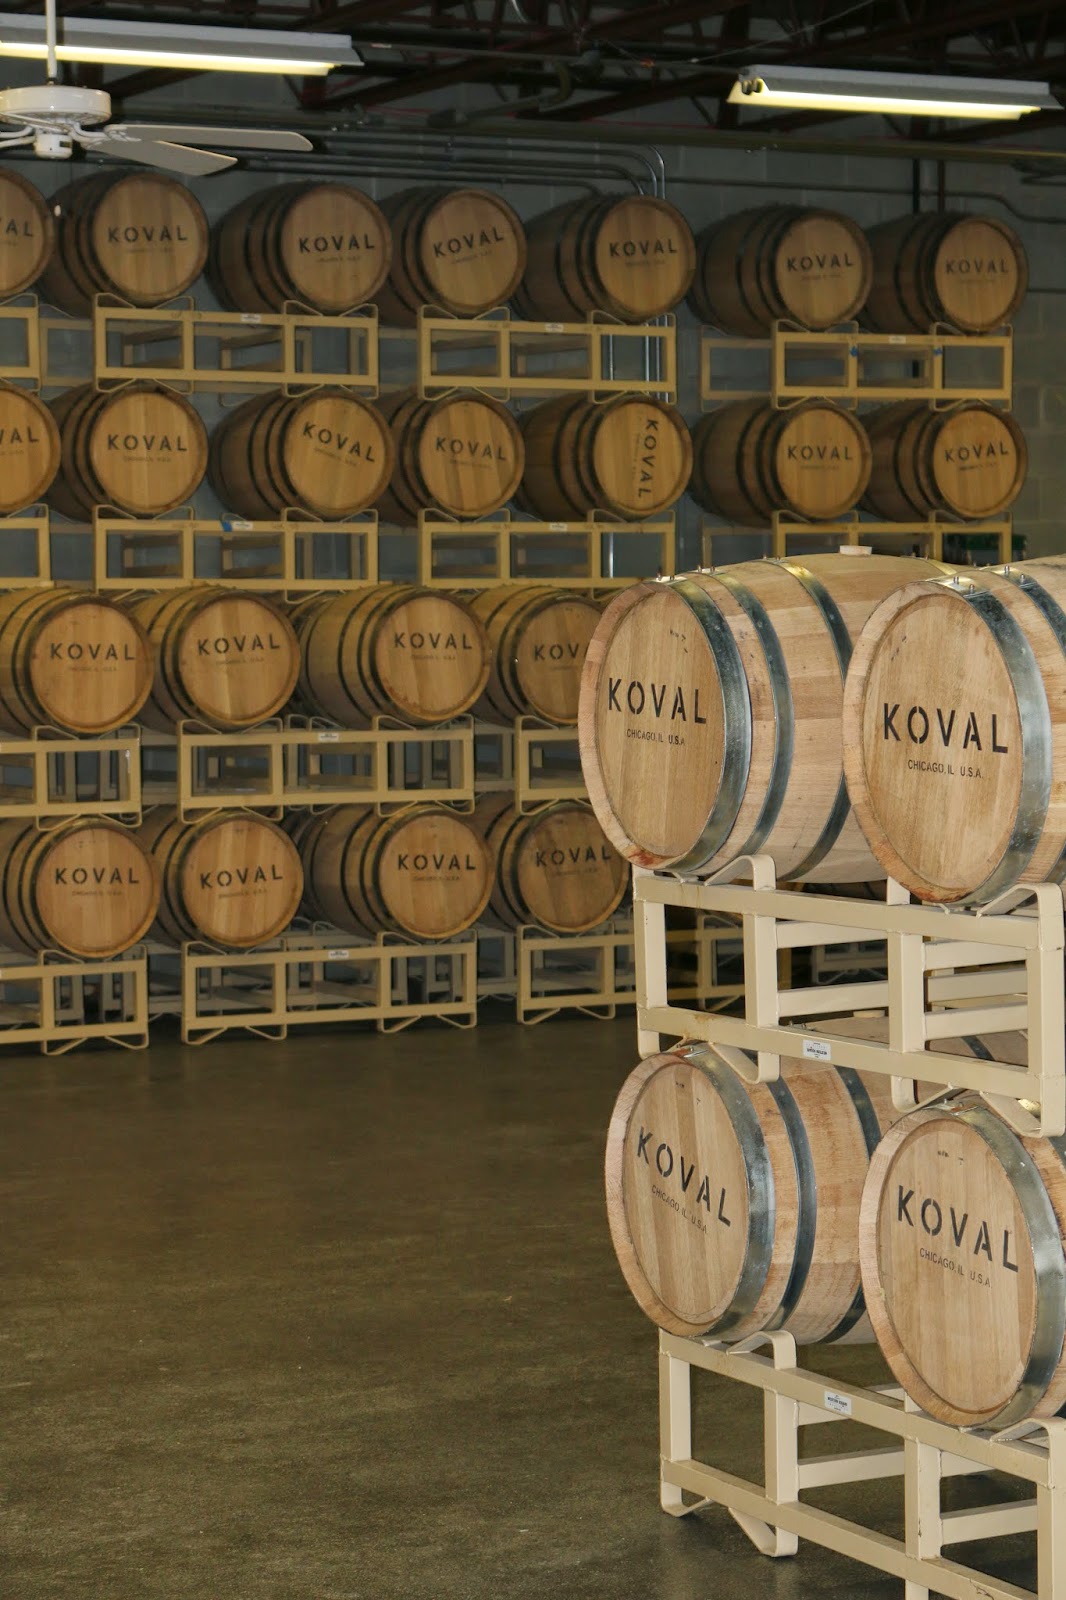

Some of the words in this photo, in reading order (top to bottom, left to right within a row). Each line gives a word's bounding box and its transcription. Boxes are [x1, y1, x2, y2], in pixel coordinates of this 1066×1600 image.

[108, 225, 188, 243] KOVAL
[299, 233, 376, 254] KOVAL
[433, 227, 504, 258] KOVAL
[609, 238, 677, 258] KOVAL
[787, 252, 854, 272] KOVAL
[945, 258, 1009, 275] KOVAL
[107, 433, 188, 452] KOVAL
[303, 421, 375, 463] KOVAL
[435, 436, 506, 461] KOVAL
[787, 445, 854, 461] KOVAL
[945, 441, 1009, 464] KOVAL
[638, 419, 658, 499] KOVAL
[50, 642, 136, 661] KOVAL
[198, 634, 281, 657] KOVAL
[393, 632, 473, 650] KOVAL
[534, 642, 590, 661] KOV
[608, 677, 706, 724] KOVAL
[883, 702, 1008, 753] KOVAL
[396, 854, 477, 871] KOVAL
[535, 844, 612, 868] KOVAL
[55, 867, 139, 885] KOVAL
[199, 864, 284, 889] KOVAL
[636, 1126, 732, 1227] KOVAL
[897, 1184, 1020, 1273] KOVAL
